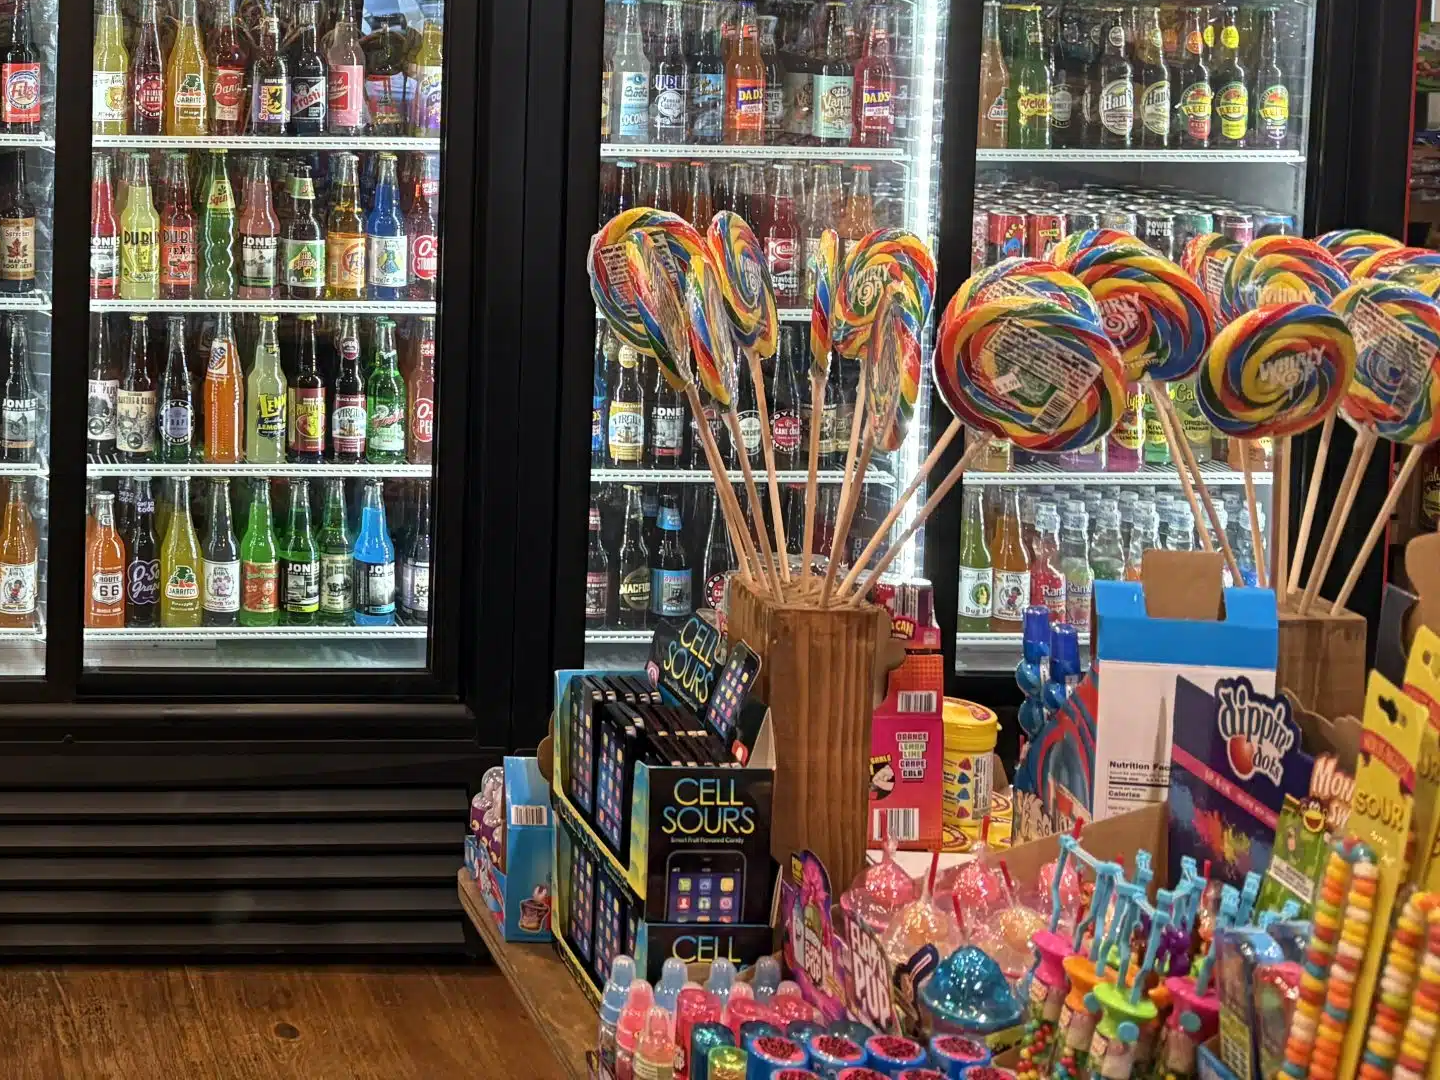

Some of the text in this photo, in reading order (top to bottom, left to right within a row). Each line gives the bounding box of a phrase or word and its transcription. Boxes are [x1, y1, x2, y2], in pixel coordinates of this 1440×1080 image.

[176, 95, 203, 104] JARRITO
[1146, 220, 1173, 229] POWER
[848, 263, 893, 292] WHIRLY
[1097, 292, 1142, 317] HIRLY
[1259, 344, 1326, 381] WHIRLY
[2, 398, 37, 409] JONES
[98, 575, 120, 583] ROUTE
[99, 584, 120, 597] 66
[896, 621, 914, 636] CAN
[680, 618, 717, 668] CELL
[664, 641, 713, 704] SOURS
[897, 733, 927, 741] ORANGE
[900, 760, 925, 768] GRAPE
[1109, 761, 1171, 771] Nutrition Fac
[1253, 749, 1283, 783] dots
[674, 778, 744, 806] CELL
[1108, 790, 1141, 798] Calories
[662, 806, 755, 834] SOURS
[725, 836, 744, 844] Candy
[672, 935, 742, 963] CELL
